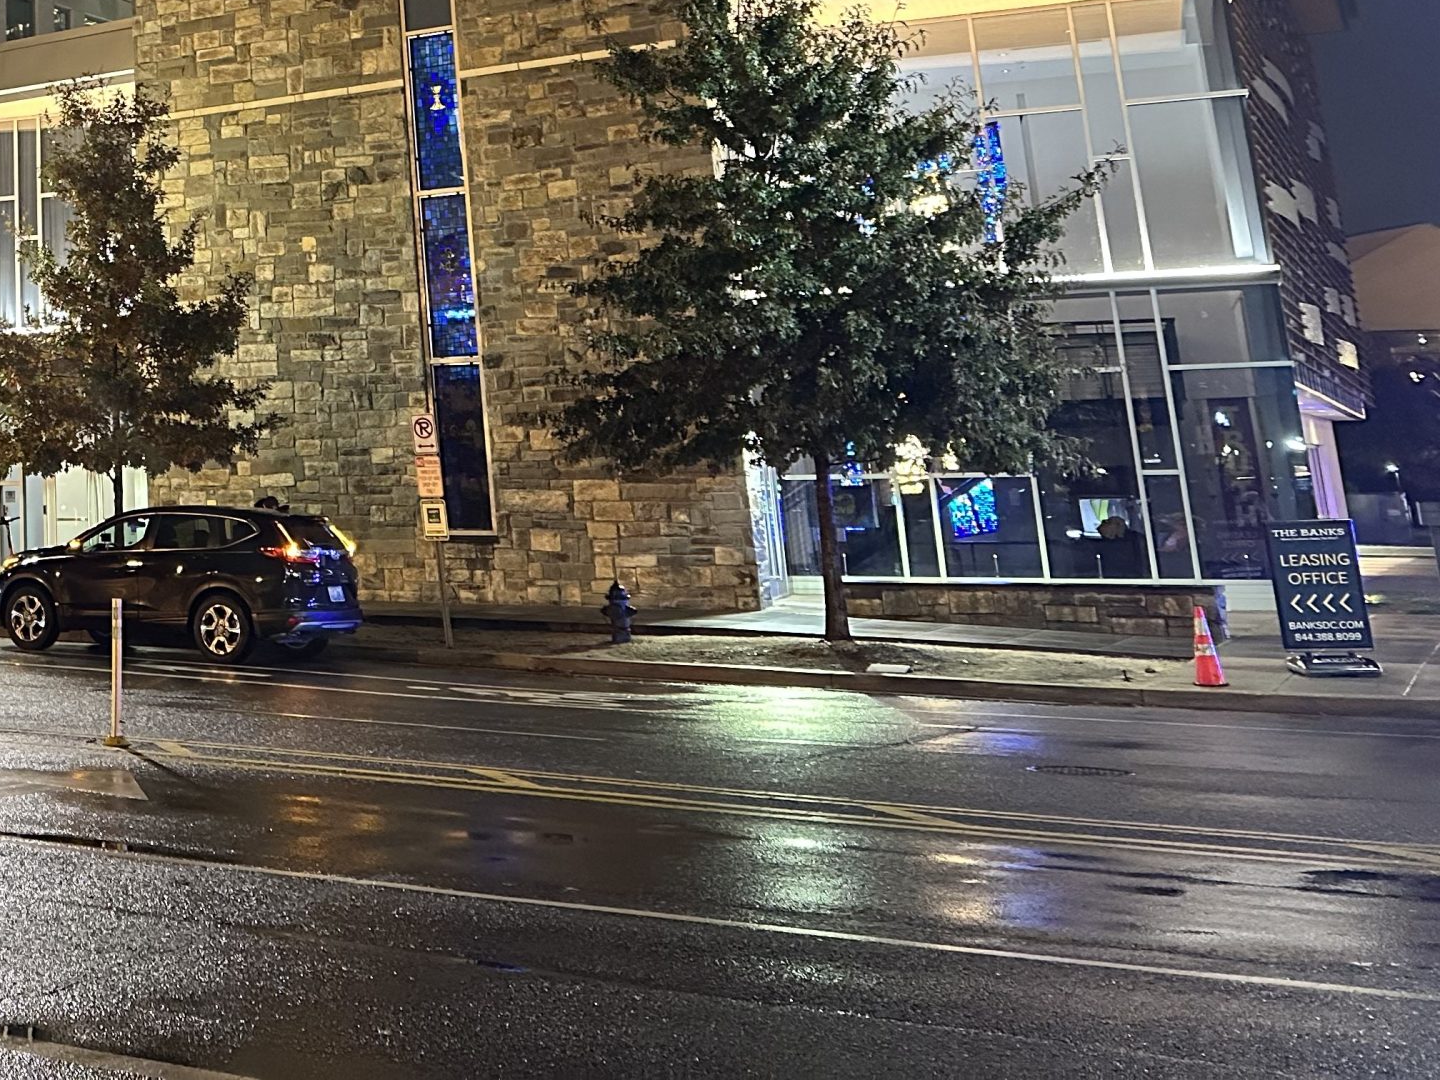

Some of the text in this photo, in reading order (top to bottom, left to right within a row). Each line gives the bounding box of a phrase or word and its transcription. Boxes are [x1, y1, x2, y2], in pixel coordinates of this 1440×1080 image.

[1271, 528, 1345, 537] THE BANKS
[1280, 553, 1351, 567] LEASING
[1288, 571, 1349, 585] OFFICE
[1288, 620, 1365, 630] BANKSDC.COM
